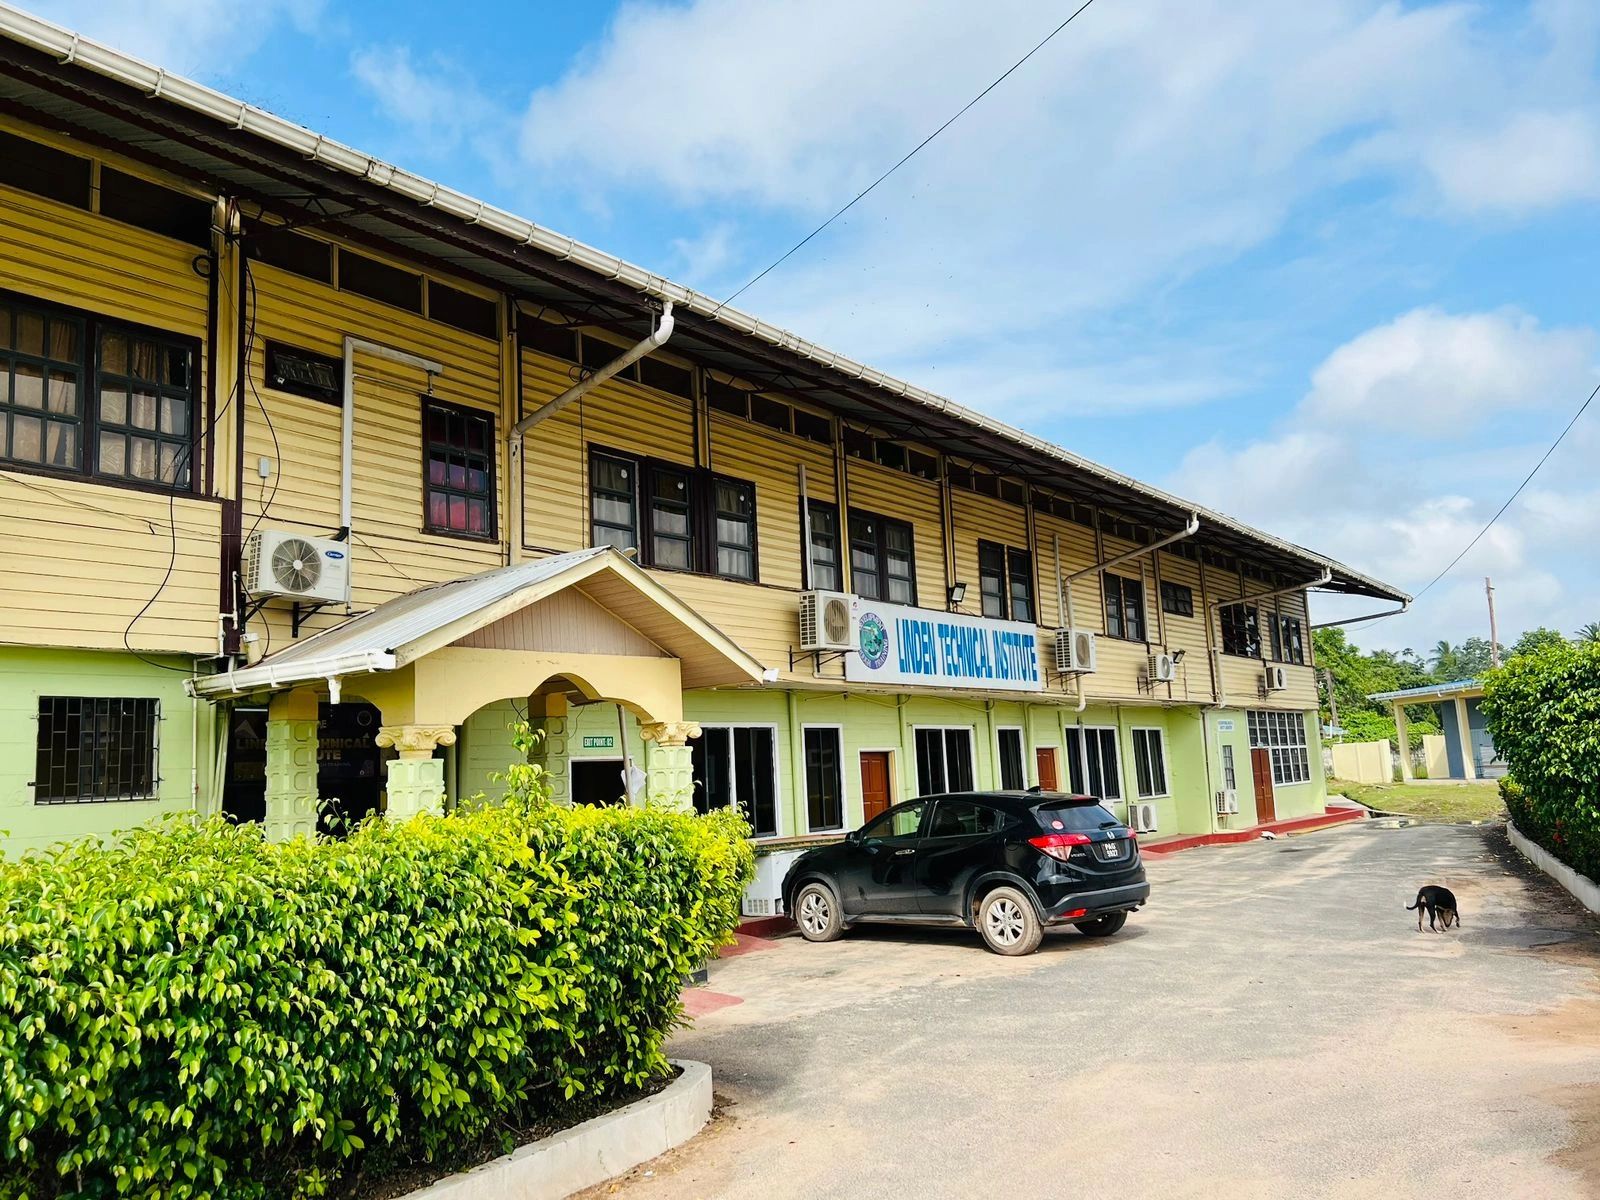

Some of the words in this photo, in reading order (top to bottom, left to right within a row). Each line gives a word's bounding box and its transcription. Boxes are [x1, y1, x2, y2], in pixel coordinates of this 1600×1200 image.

[896, 618, 937, 675] LINDEN
[938, 623, 992, 679] TECHNICAL
[992, 629, 1038, 682] INSTITUTE
[584, 737, 593, 746] EXIT
